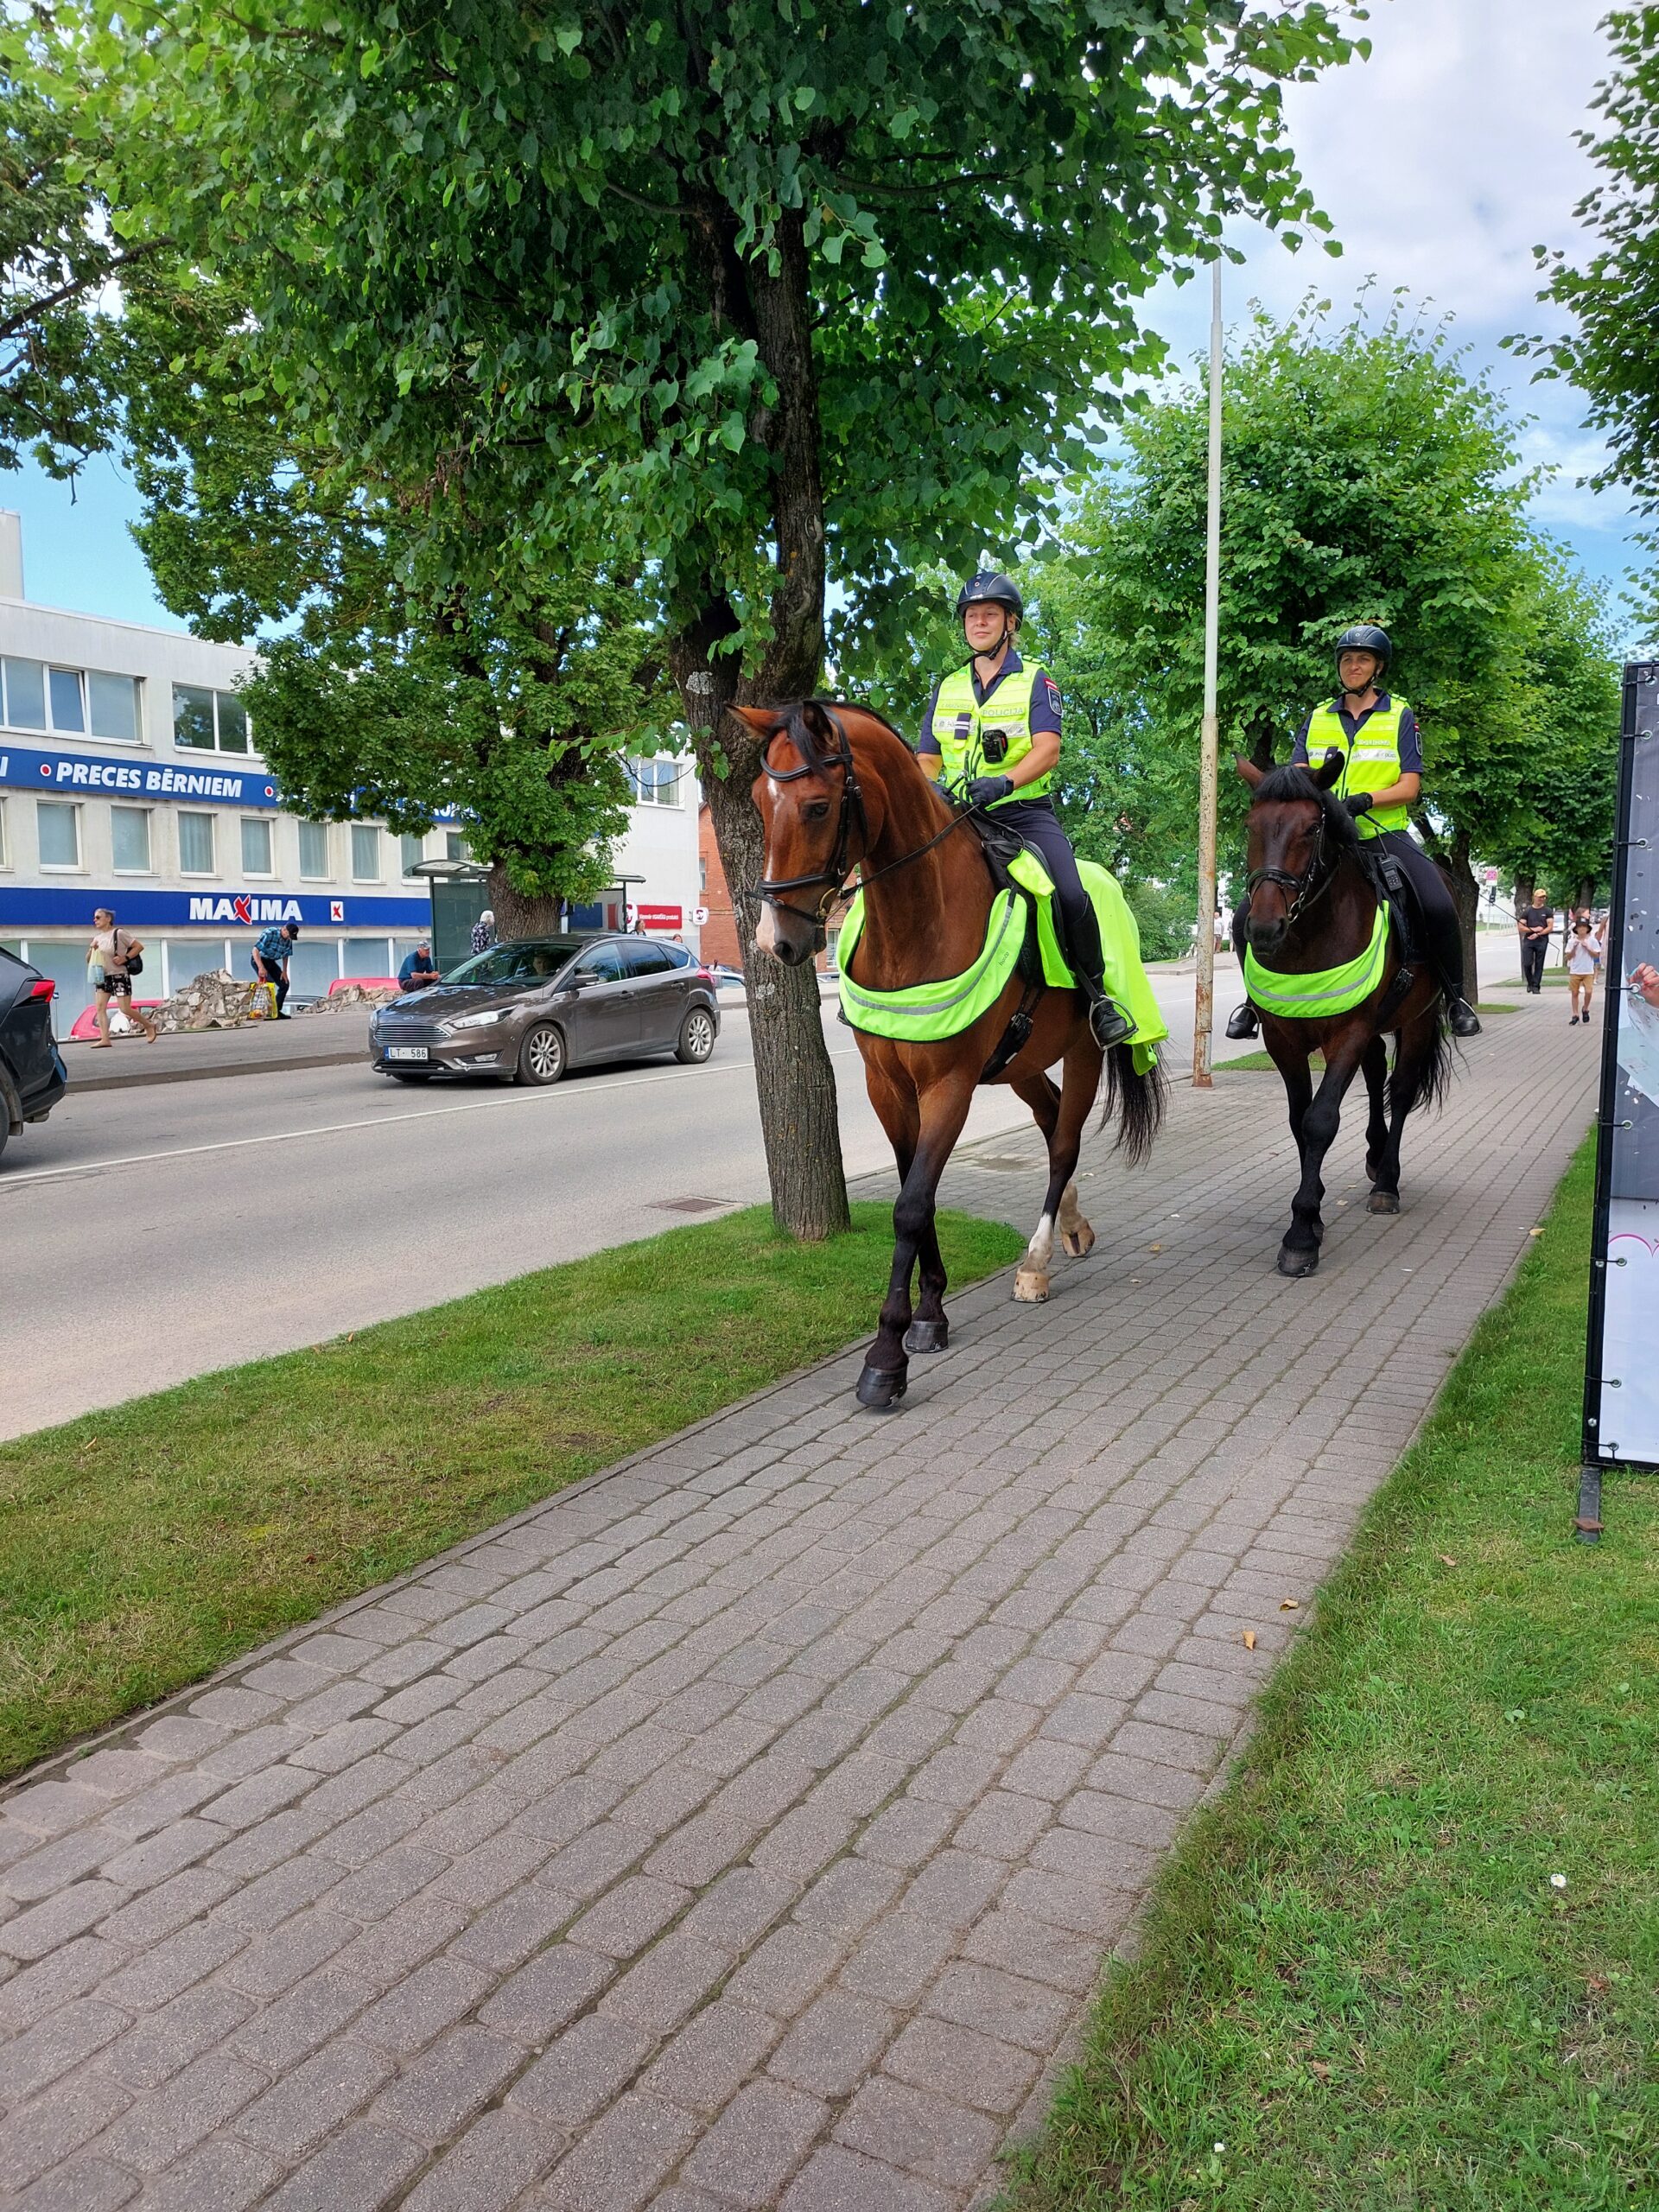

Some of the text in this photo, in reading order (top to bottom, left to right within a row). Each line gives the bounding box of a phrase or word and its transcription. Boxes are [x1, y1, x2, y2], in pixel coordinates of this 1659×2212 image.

[982, 708, 1023, 716] POLICIJA
[56, 761, 243, 798] PRECES BĒRNIEM
[189, 894, 303, 925] MAXIMA
